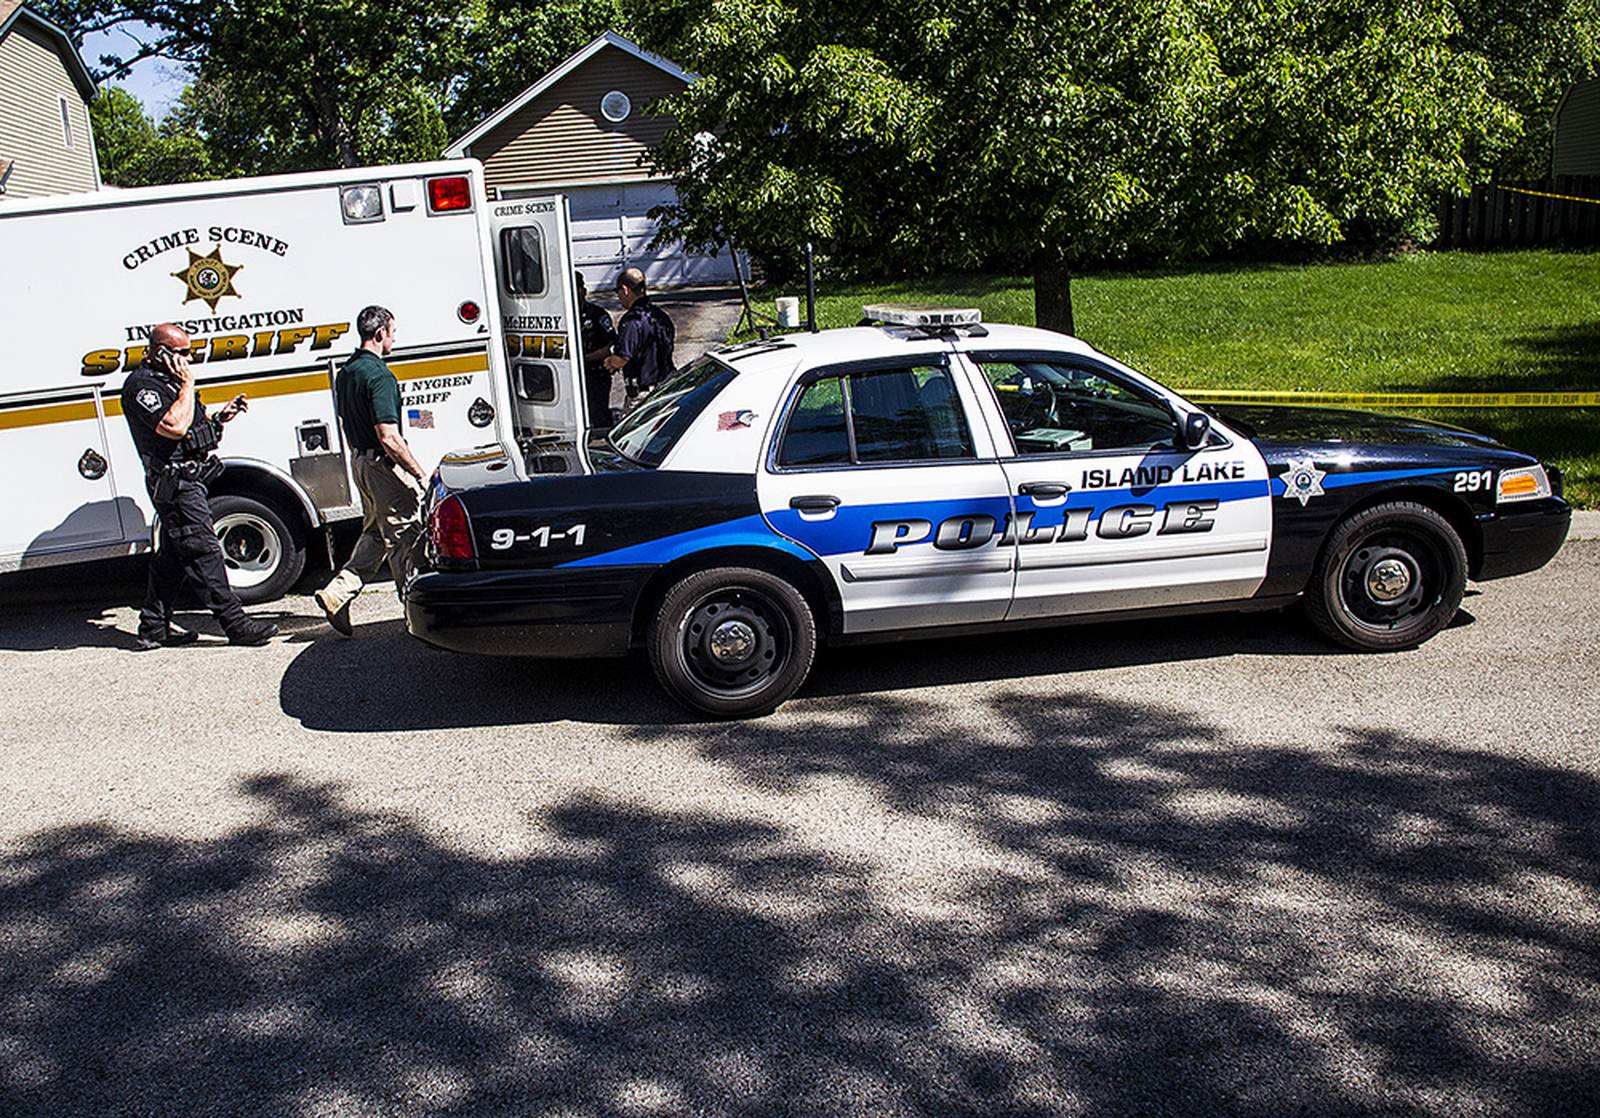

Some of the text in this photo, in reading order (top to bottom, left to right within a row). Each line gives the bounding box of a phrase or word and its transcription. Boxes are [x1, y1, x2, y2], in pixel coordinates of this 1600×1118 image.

[494, 201, 556, 217] CRIME SCENE
[122, 226, 289, 271] CRIME SCENE
[125, 308, 305, 342] INSTIGATION
[503, 315, 562, 330] McHENRY
[411, 374, 474, 392] NYGREN
[1080, 460, 1246, 489] ISLAND LAKE
[1453, 469, 1493, 493] 291
[490, 523, 587, 550] 9-1-1
[863, 499, 1220, 556] POLICE
